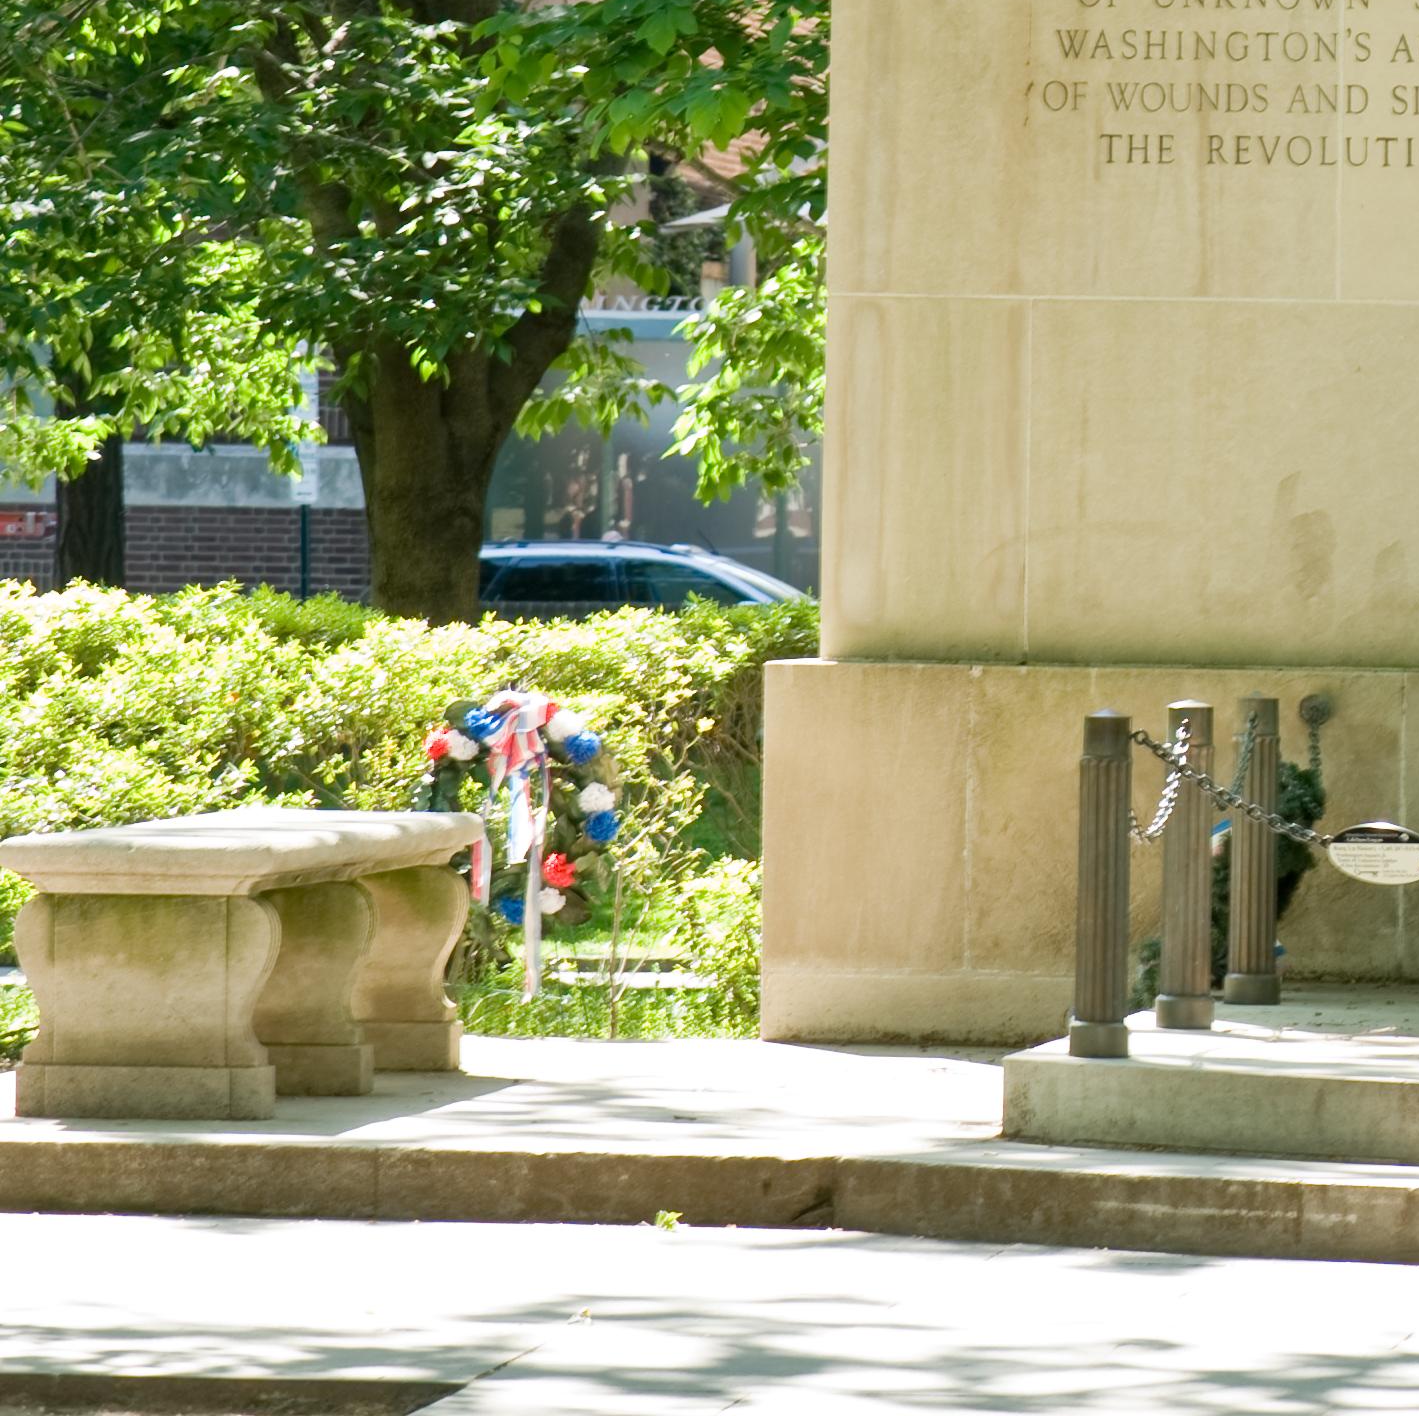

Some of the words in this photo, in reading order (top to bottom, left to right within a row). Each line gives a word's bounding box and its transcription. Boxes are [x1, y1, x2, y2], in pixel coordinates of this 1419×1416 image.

[1055, 28, 1371, 63] WASHINGTON'S
[1042, 80, 1088, 112] OF
[1106, 82, 1269, 113] WOUNDS
[1286, 84, 1369, 115] AND
[1099, 134, 1174, 164] THE
